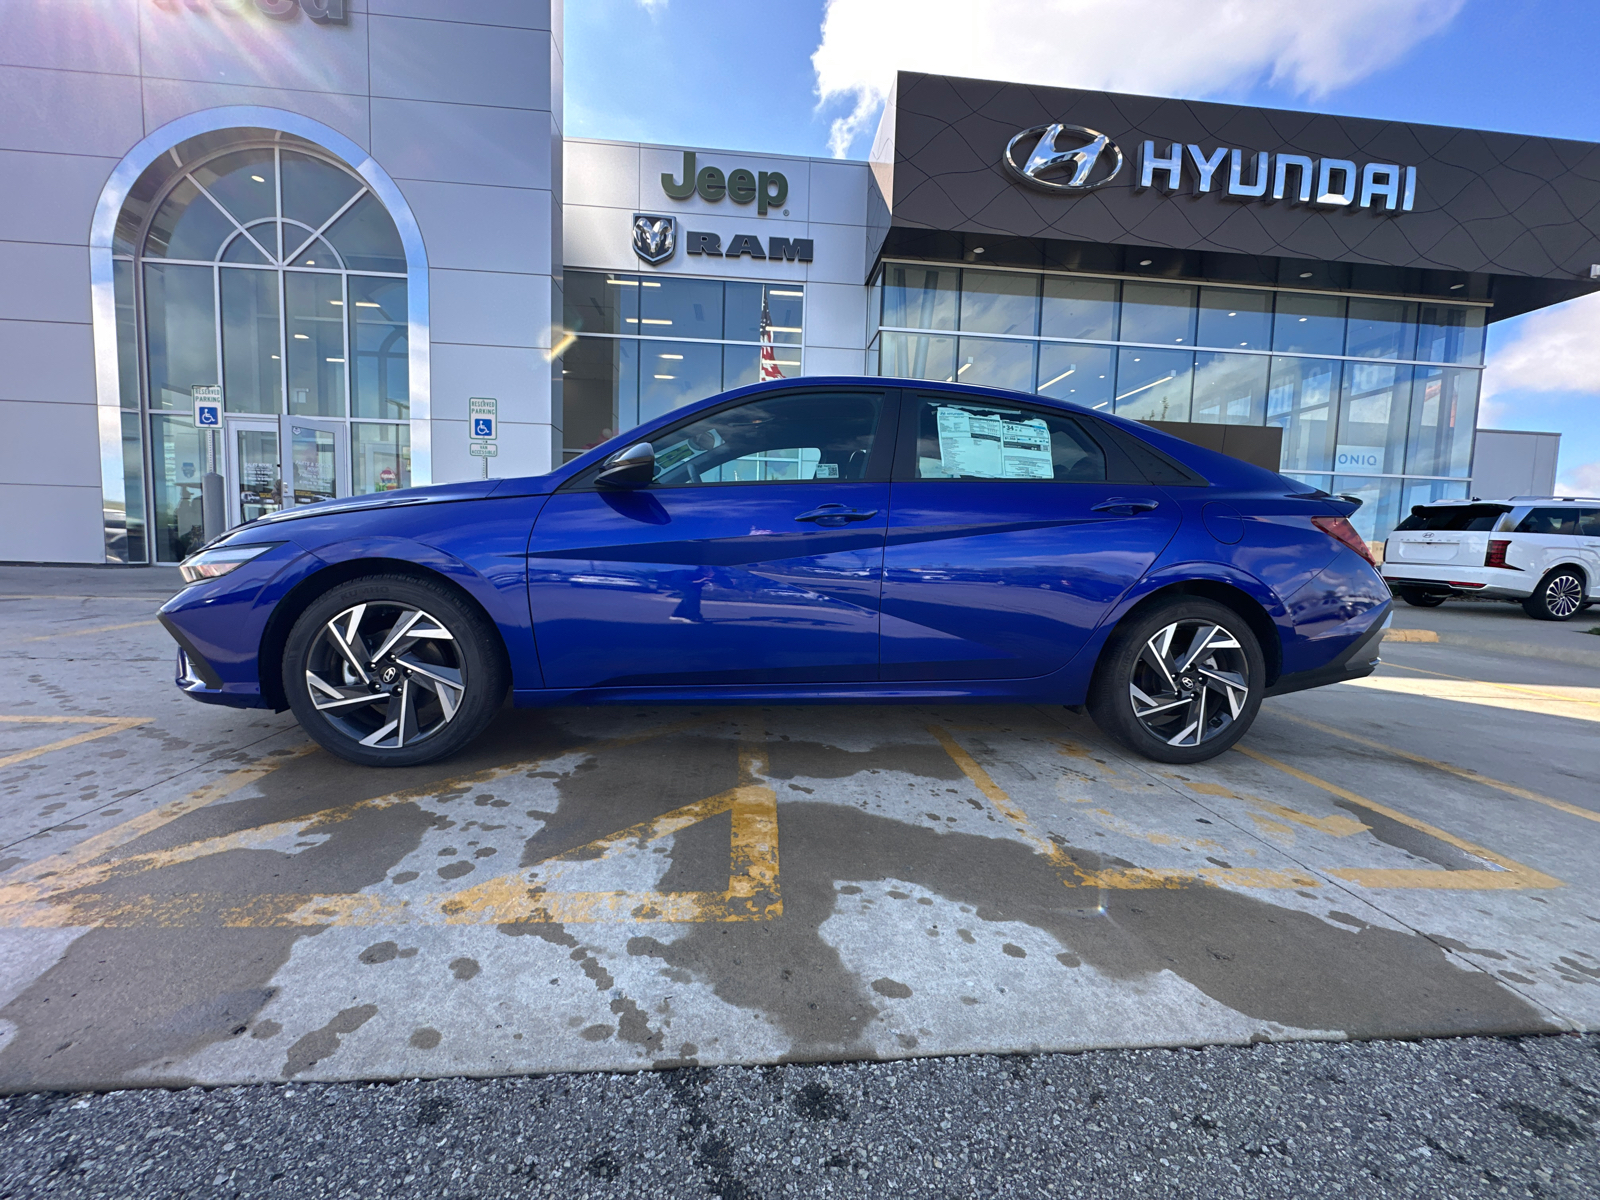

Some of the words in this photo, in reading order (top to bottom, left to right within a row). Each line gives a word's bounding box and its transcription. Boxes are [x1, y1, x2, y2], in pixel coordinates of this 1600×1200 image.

[660, 151, 789, 216] Jeep
[1137, 139, 1417, 212] HYUNDAI
[686, 230, 814, 263] RAM
[1338, 453, 1377, 466] ONIQ
